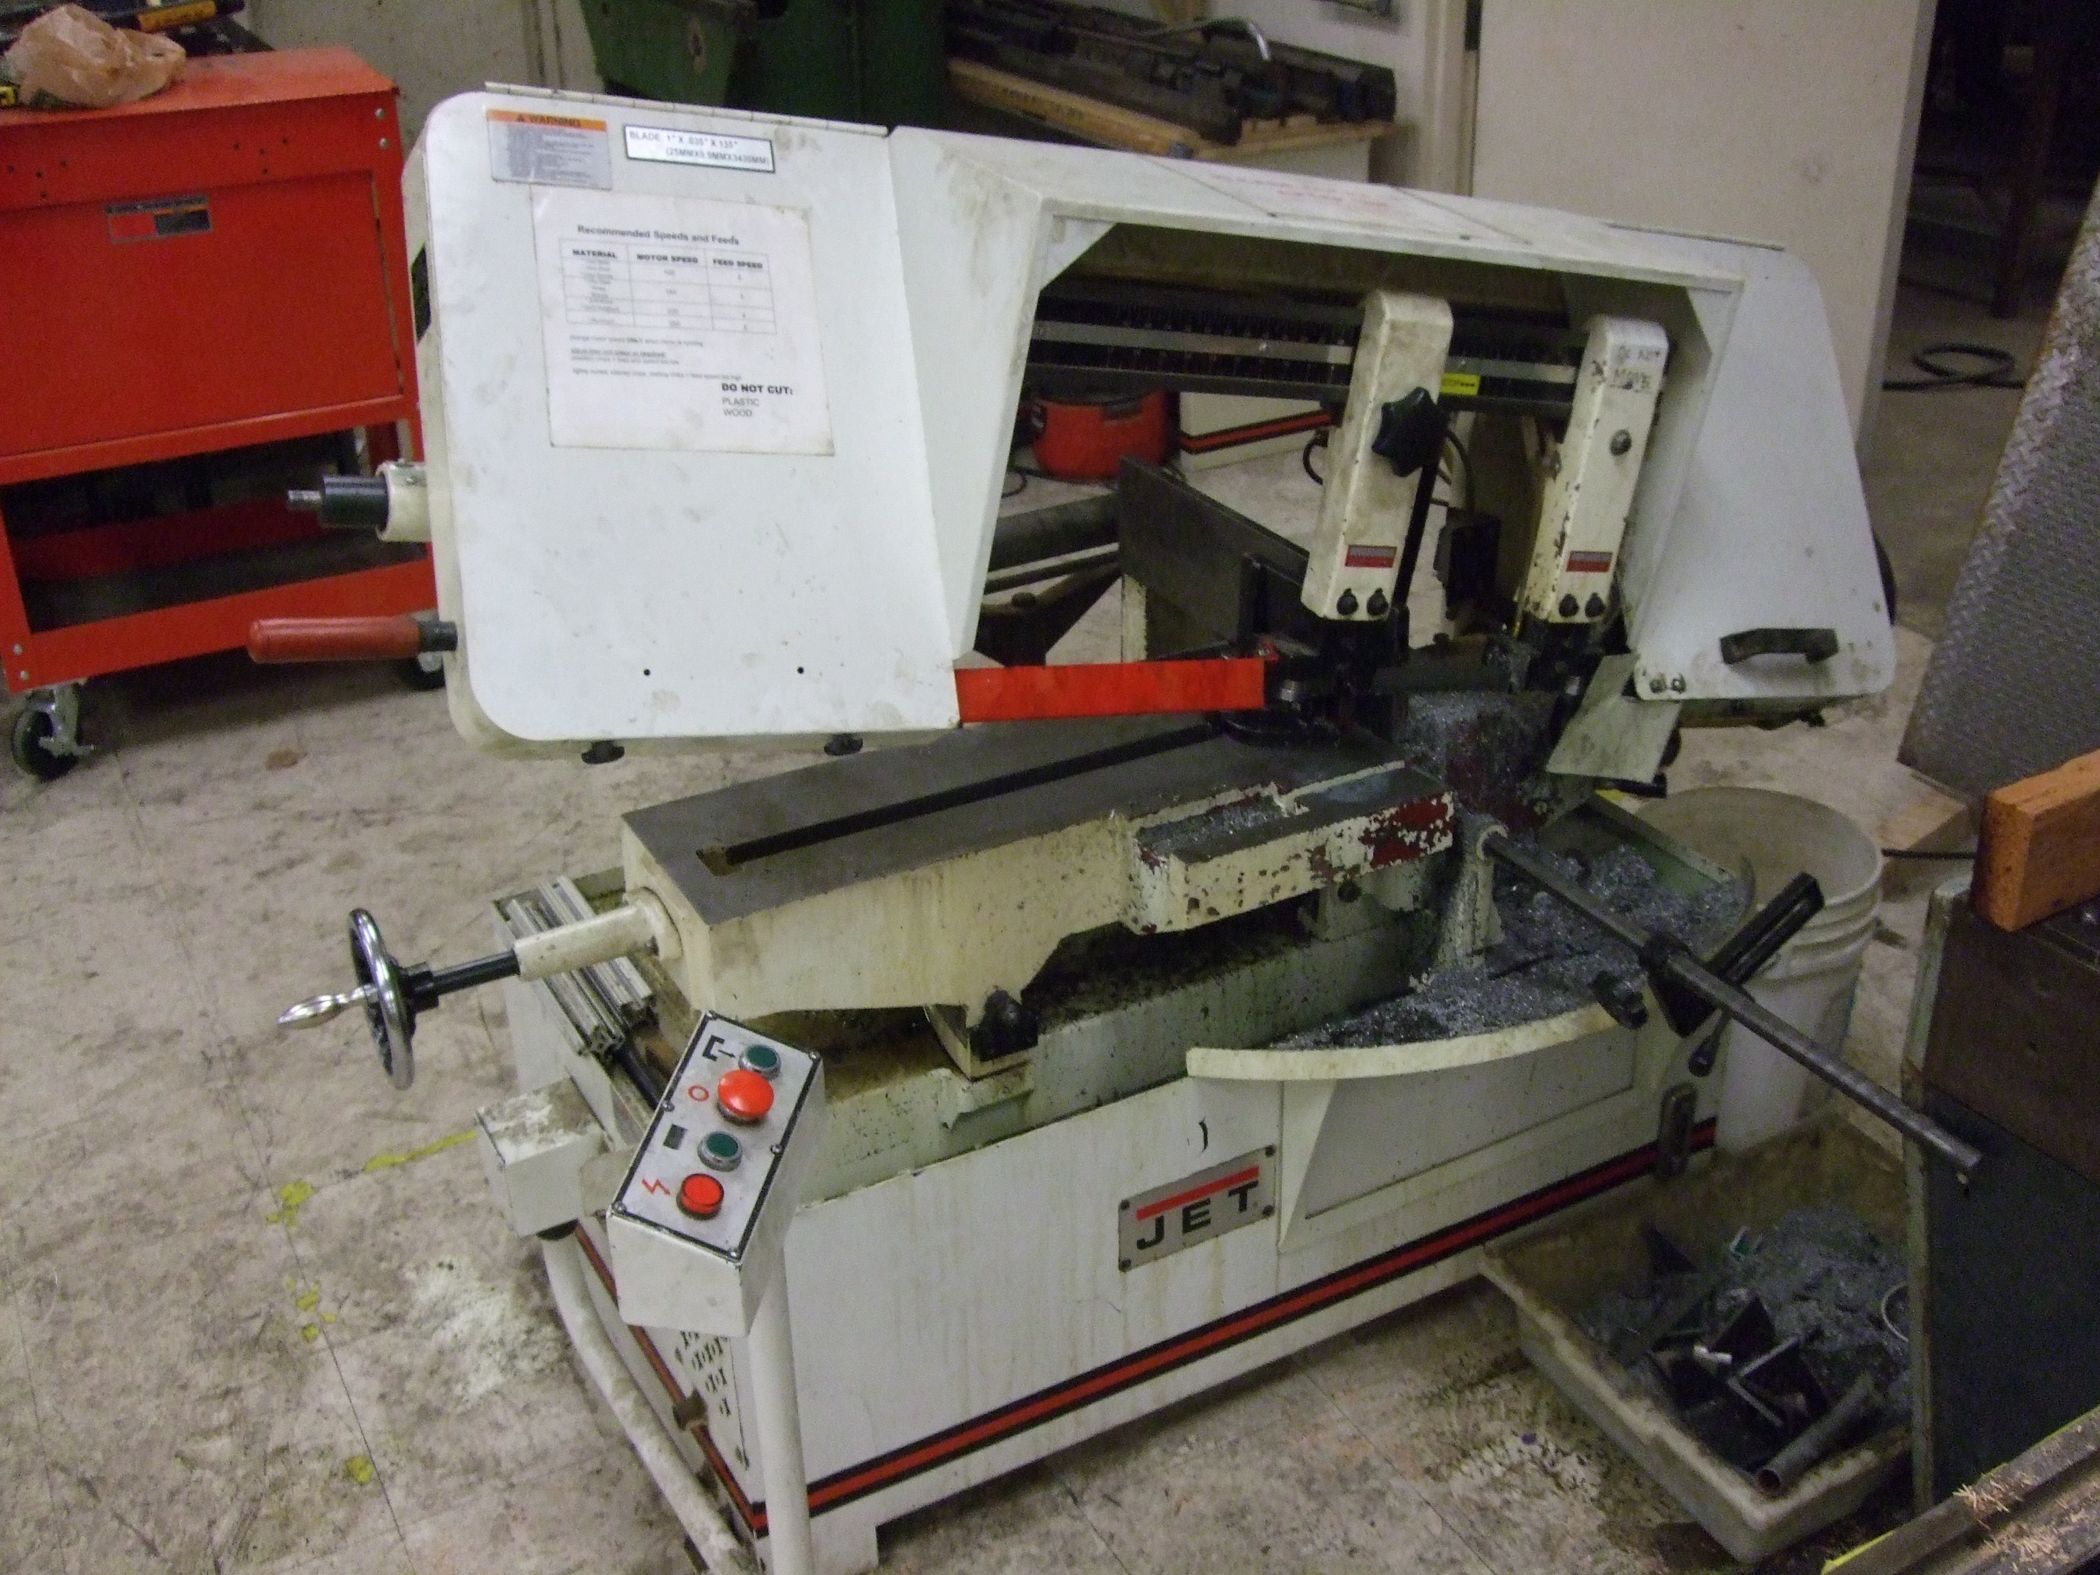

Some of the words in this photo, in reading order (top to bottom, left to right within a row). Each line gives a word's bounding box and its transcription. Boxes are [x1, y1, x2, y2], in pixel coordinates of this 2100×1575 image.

[528, 113, 581, 129] WARNING
[577, 224, 651, 239] Recommended
[653, 230, 690, 242] Speeds
[691, 234, 710, 243] and
[711, 235, 740, 246] Feeds
[572, 248, 618, 260] MATERIAL
[636, 253, 669, 262] MOTOR
[671, 255, 699, 264] SPEED
[712, 258, 735, 267] FEED
[736, 260, 763, 269] SPEED
[721, 382, 738, 393] DO
[741, 384, 763, 394] NOT
[767, 386, 793, 396] CUT:
[722, 397, 759, 407] PLASTIC
[723, 408, 753, 417] WOOD
[1136, 1179, 1260, 1251] JET
